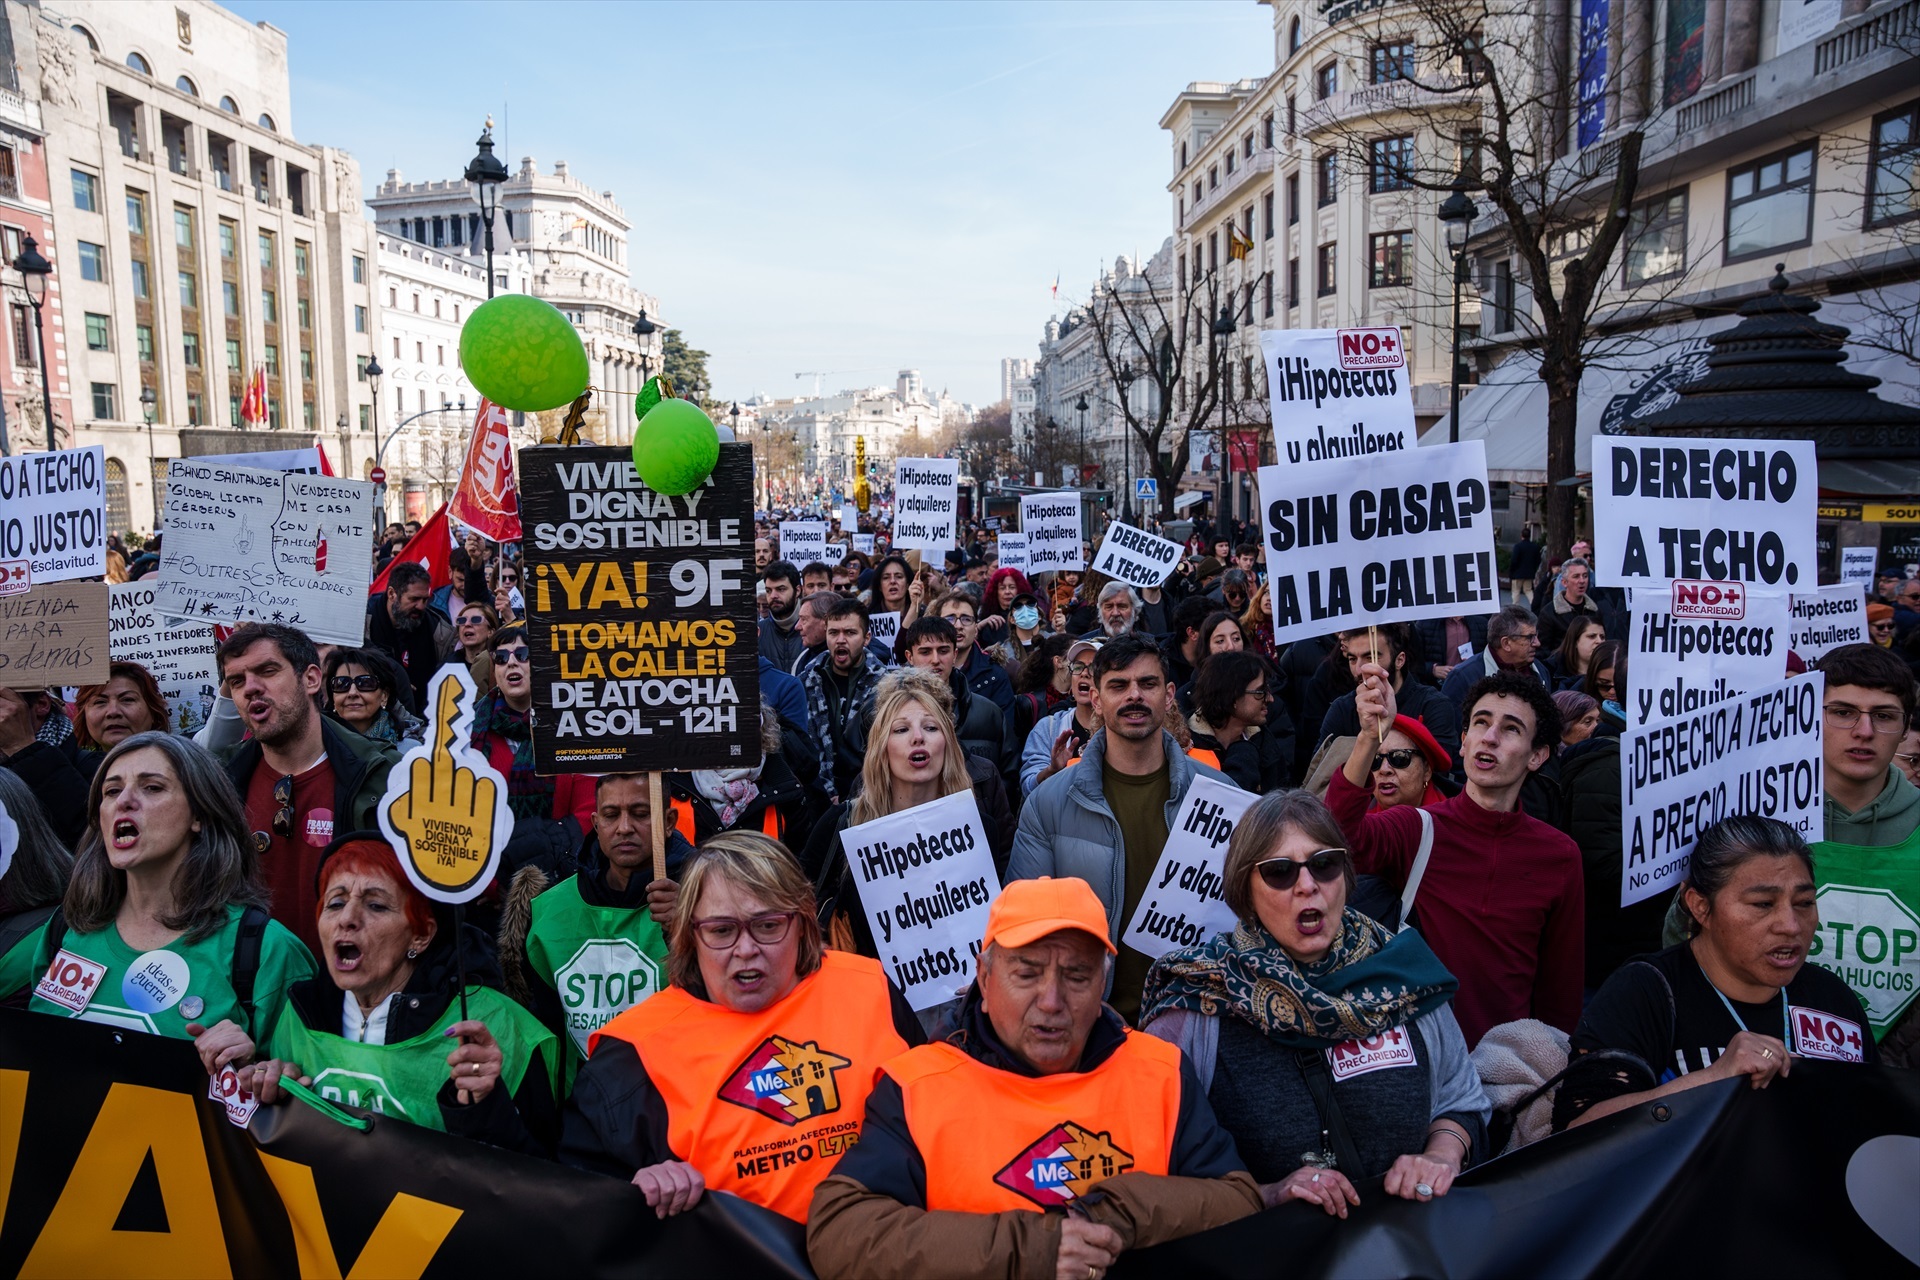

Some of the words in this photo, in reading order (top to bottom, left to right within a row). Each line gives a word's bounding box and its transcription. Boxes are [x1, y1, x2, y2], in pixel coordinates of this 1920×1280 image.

[1342, 333, 1396, 356] NO+
[1344, 354, 1400, 366] PRECARIEDAD
[19, 460, 31, 498] A
[34, 451, 100, 496] TECHO,
[214, 470, 281, 487] SANTANDER
[555, 461, 715, 490] VIVIE
[900, 467, 952, 488] ¡Hipotecas
[1612, 446, 1797, 503] DERECHO
[290, 483, 361, 499] VENDIERON
[170, 500, 236, 518] CERBERUS
[287, 501, 307, 512] MI
[316, 504, 351, 513] CASA
[569, 490, 676, 520] DIGNA
[682, 489, 705, 517] Y
[899, 501, 905, 514] y
[907, 494, 951, 514] alquileres
[1026, 504, 1076, 521] ¡Hipotecas
[1269, 493, 1338, 552] SIN
[1350, 478, 1486, 541] CASA?
[29, 508, 102, 556] JUSTO!
[170, 518, 215, 531] SOLVIA
[279, 521, 308, 531] CON
[337, 525, 363, 536] MI
[534, 518, 742, 551] SOSTENIBLE
[783, 529, 822, 543] ¡Hipotecas
[897, 520, 929, 541] justos,
[932, 522, 949, 542] ya!
[1028, 531, 1034, 544] y
[1035, 525, 1077, 542] alquileres
[274, 535, 317, 549] FAMILIA
[1111, 525, 1175, 564] DERECHO
[789, 548, 822, 562] alquileres
[1030, 549, 1060, 566] justos,
[1062, 546, 1078, 563] ya!
[1102, 553, 1115, 572] A
[1621, 525, 1651, 577] A
[1658, 527, 1799, 586] TECHO.
[536, 561, 649, 612] ¡YA!
[669, 559, 743, 609] 9F
[1278, 574, 1302, 628] A
[1307, 566, 1353, 621] LA
[1361, 551, 1492, 613] CALLE!
[1678, 584, 1740, 605] NO+
[0, 596, 79, 619] VIENDA
[109, 590, 157, 611] ANCO
[1676, 605, 1741, 616] PRECARIEDAD
[5, 621, 63, 640] PARA
[109, 614, 155, 632] ONDOS
[869, 616, 896, 637] RECHO
[109, 634, 150, 648] ANDES
[155, 628, 213, 642] TENEDORES
[551, 619, 737, 652] ¡TOMAMOS
[1640, 612, 1774, 661] ¡Hipotecas
[1790, 633, 1798, 650] y
[1801, 625, 1860, 648] alquileres
[14, 637, 94, 671] demás
[110, 650, 154, 663] EQUEÑOS
[157, 645, 216, 658] INVERSORES
[560, 651, 606, 680] LA
[609, 649, 726, 678] CALLE!
[172, 670, 209, 681] JUGAR
[551, 681, 596, 709] DE
[600, 677, 739, 708] ATOCHA
[1638, 689, 1653, 725] y
[1660, 677, 1747, 717] alquil
[555, 710, 582, 737] A
[585, 708, 653, 737] SOL
[680, 705, 737, 734] 12H
[1628, 707, 1726, 806] ¡DERECHO
[1727, 703, 1743, 754] A
[1747, 681, 1820, 742] TECHO,
[1628, 815, 1646, 868] A
[1651, 781, 1726, 859] PRECIO
[1731, 757, 1820, 818] JUSTO!
[422, 818, 473, 837] VIVIENDA
[425, 830, 458, 847] DIGNA
[462, 837, 470, 848] Y
[415, 839, 479, 861] SOSTENIBLE
[437, 854, 456, 868] ¡YA!
[857, 823, 975, 883] ¡Hipotecas
[1158, 859, 1181, 889] y
[1629, 872, 1650, 891] No
[1653, 854, 1692, 880] comp
[876, 910, 891, 943] y
[895, 876, 989, 930] alquileres
[143, 962, 173, 987] ideas
[892, 946, 968, 994] justos,
[130, 972, 167, 1003] guerra
[564, 968, 648, 1008] STOP
[1799, 1013, 1861, 1050] NO+
[1338, 1049, 1409, 1071] PRECARIEDAD
[733, 1137, 798, 1158] PLATAFORMA
[800, 1121, 858, 1141] AFECTADOS
[736, 1145, 813, 1179] METRO
